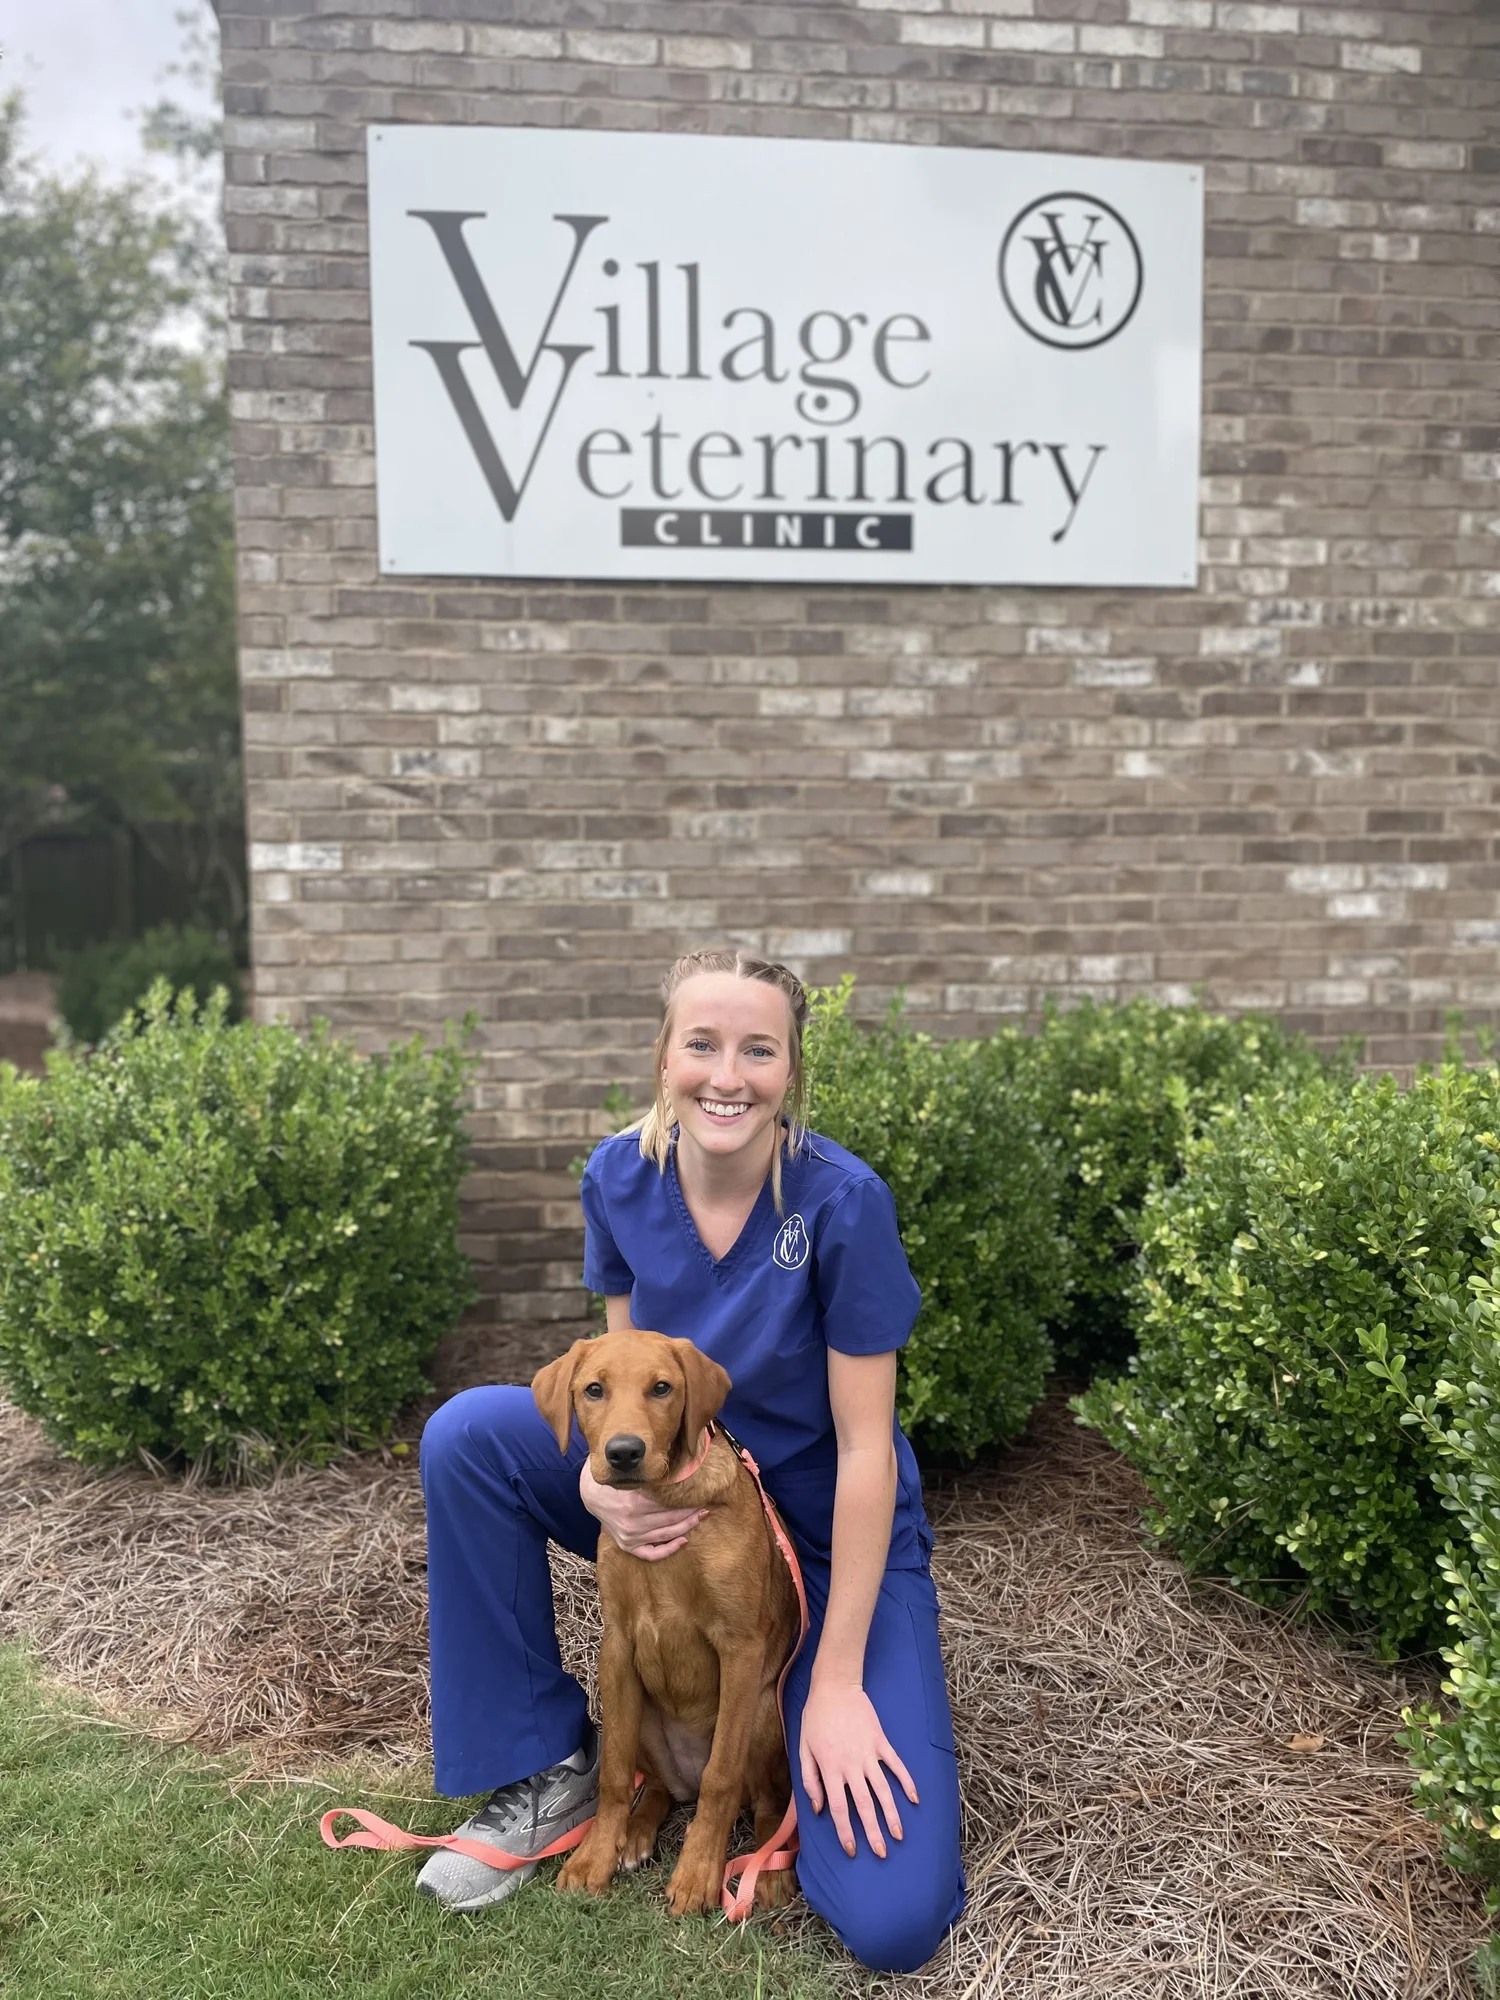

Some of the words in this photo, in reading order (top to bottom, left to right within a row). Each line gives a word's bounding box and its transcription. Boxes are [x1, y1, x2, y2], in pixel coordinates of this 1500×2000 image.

[406, 210, 932, 426] Village
[407, 340, 1107, 544] Veterinary
[654, 513, 881, 547] CLINIC
